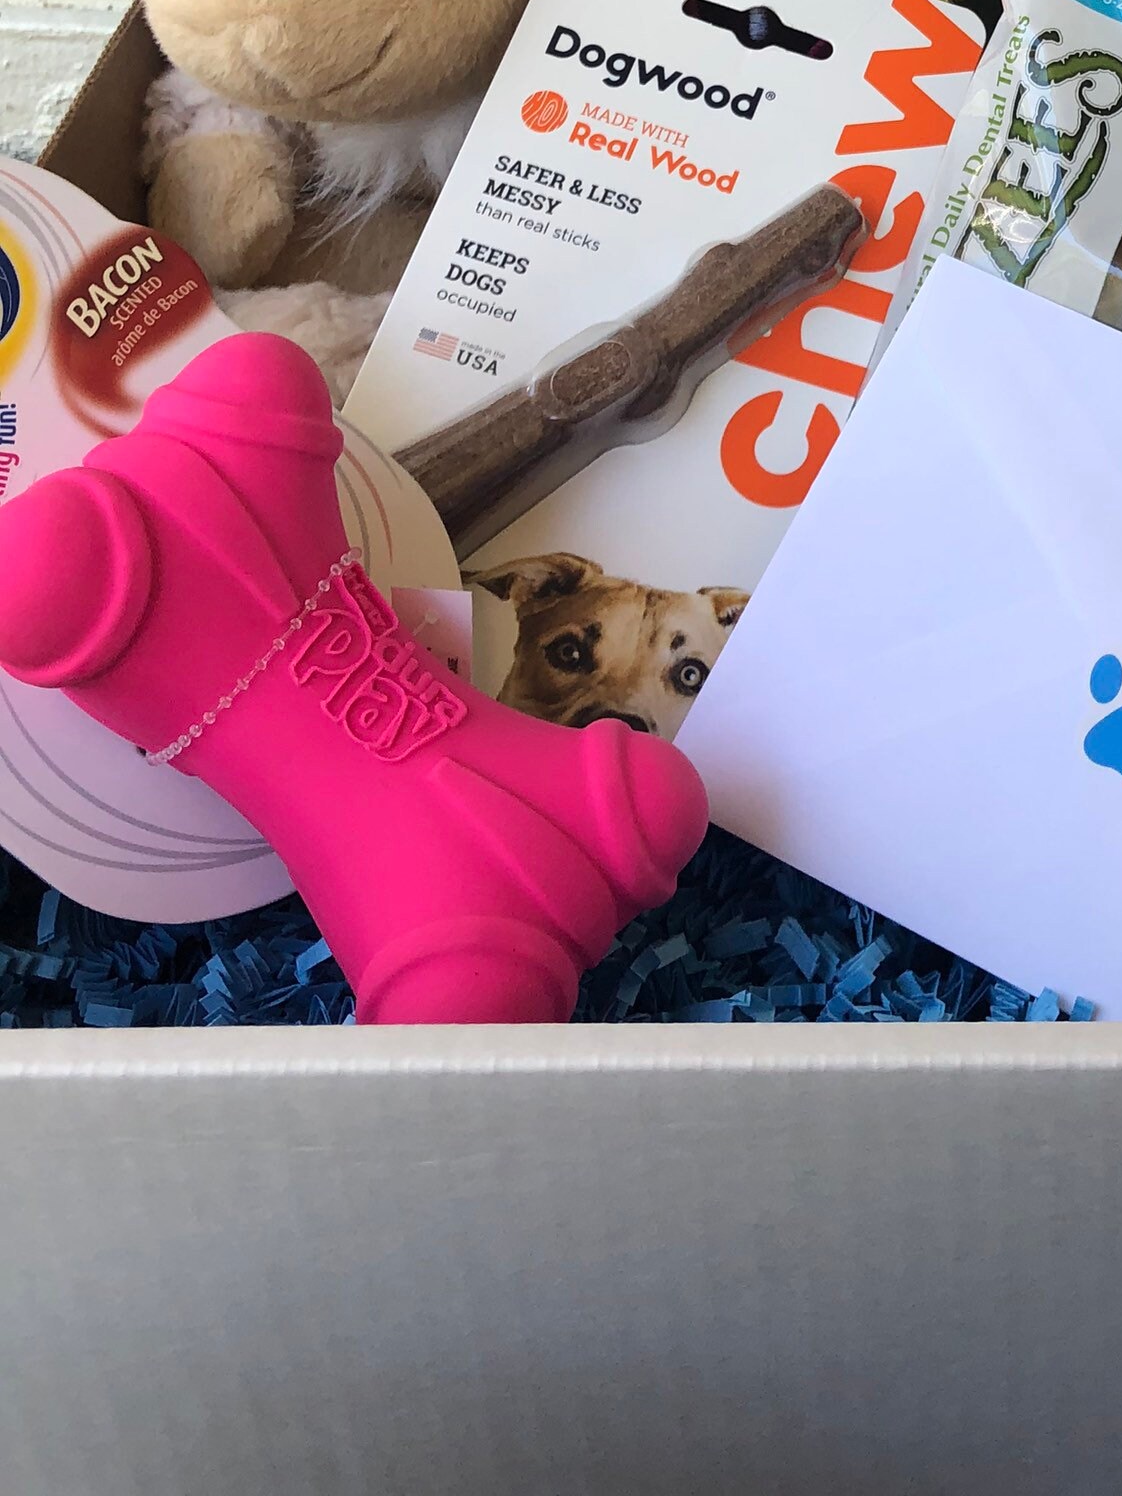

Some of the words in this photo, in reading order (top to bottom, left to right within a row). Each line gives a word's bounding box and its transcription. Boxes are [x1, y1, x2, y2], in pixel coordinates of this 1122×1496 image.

[580, 103, 638, 132] MADE
[641, 121, 689, 149] WITH
[931, 182, 972, 249] Daily
[962, 93, 1008, 177] Dental
[996, 14, 1031, 87] Treats
[569, 121, 639, 161] Real
[650, 145, 740, 194] Wood
[482, 178, 563, 215] MESSY
[494, 155, 565, 192] SAFER
[569, 179, 584, 197] &
[586, 184, 643, 216] LESS
[475, 200, 513, 224] than
[517, 215, 550, 236] real
[552, 226, 601, 252] sticks
[445, 263, 507, 296] DOGS
[456, 238, 530, 275] KEEPS
[66, 236, 164, 338] BACON
[109, 276, 163, 331] SCENTED
[436, 289, 517, 323] occupied
[112, 323, 147, 367] arôme
[143, 307, 162, 327] de
[157, 279, 199, 312] Bacon
[461, 340, 484, 353] made
[456, 349, 499, 377] USA
[290, 608, 449, 762] Play
